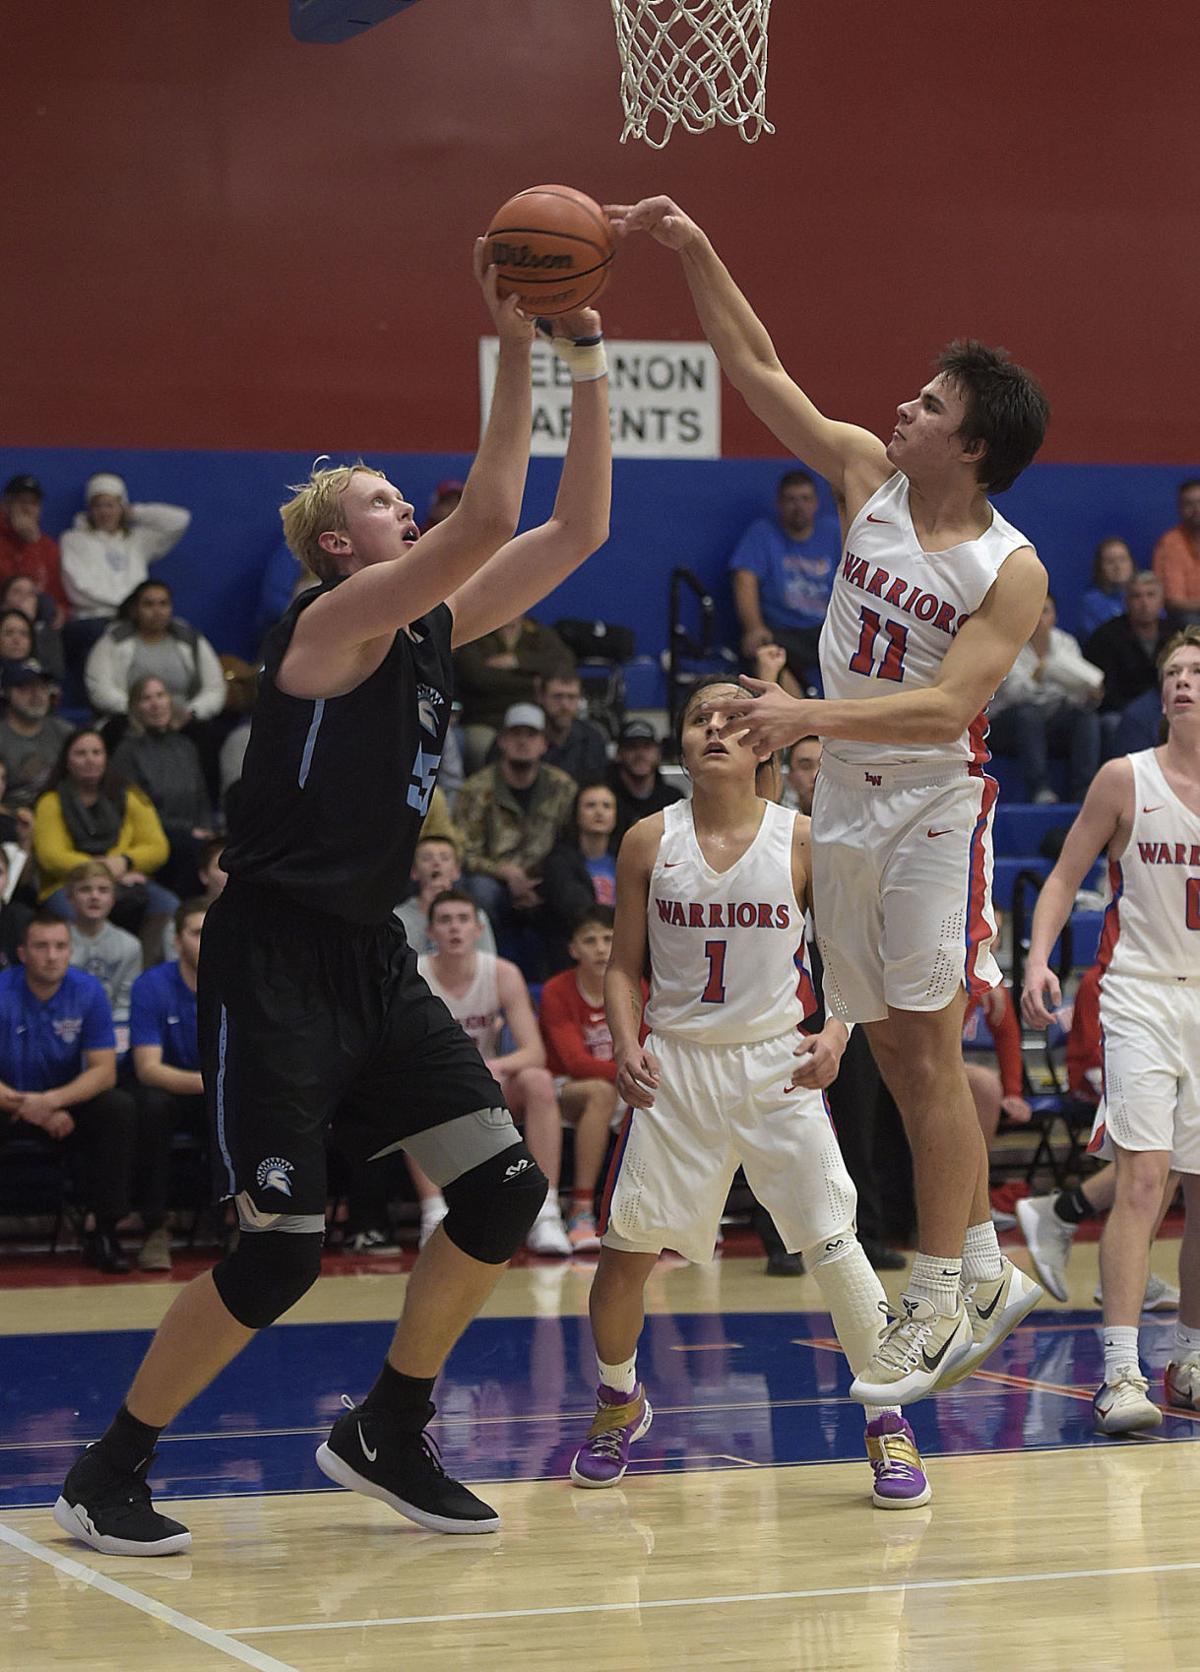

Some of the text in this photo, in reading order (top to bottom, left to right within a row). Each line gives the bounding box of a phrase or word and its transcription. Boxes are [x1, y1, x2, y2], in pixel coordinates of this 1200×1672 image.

[493, 242, 574, 269] Wilson
[498, 353, 705, 391] EBNON
[531, 407, 702, 443] ANTS
[849, 605, 909, 683] 11
[655, 898, 791, 930] WARRIORS
[701, 940, 727, 1004] 1
